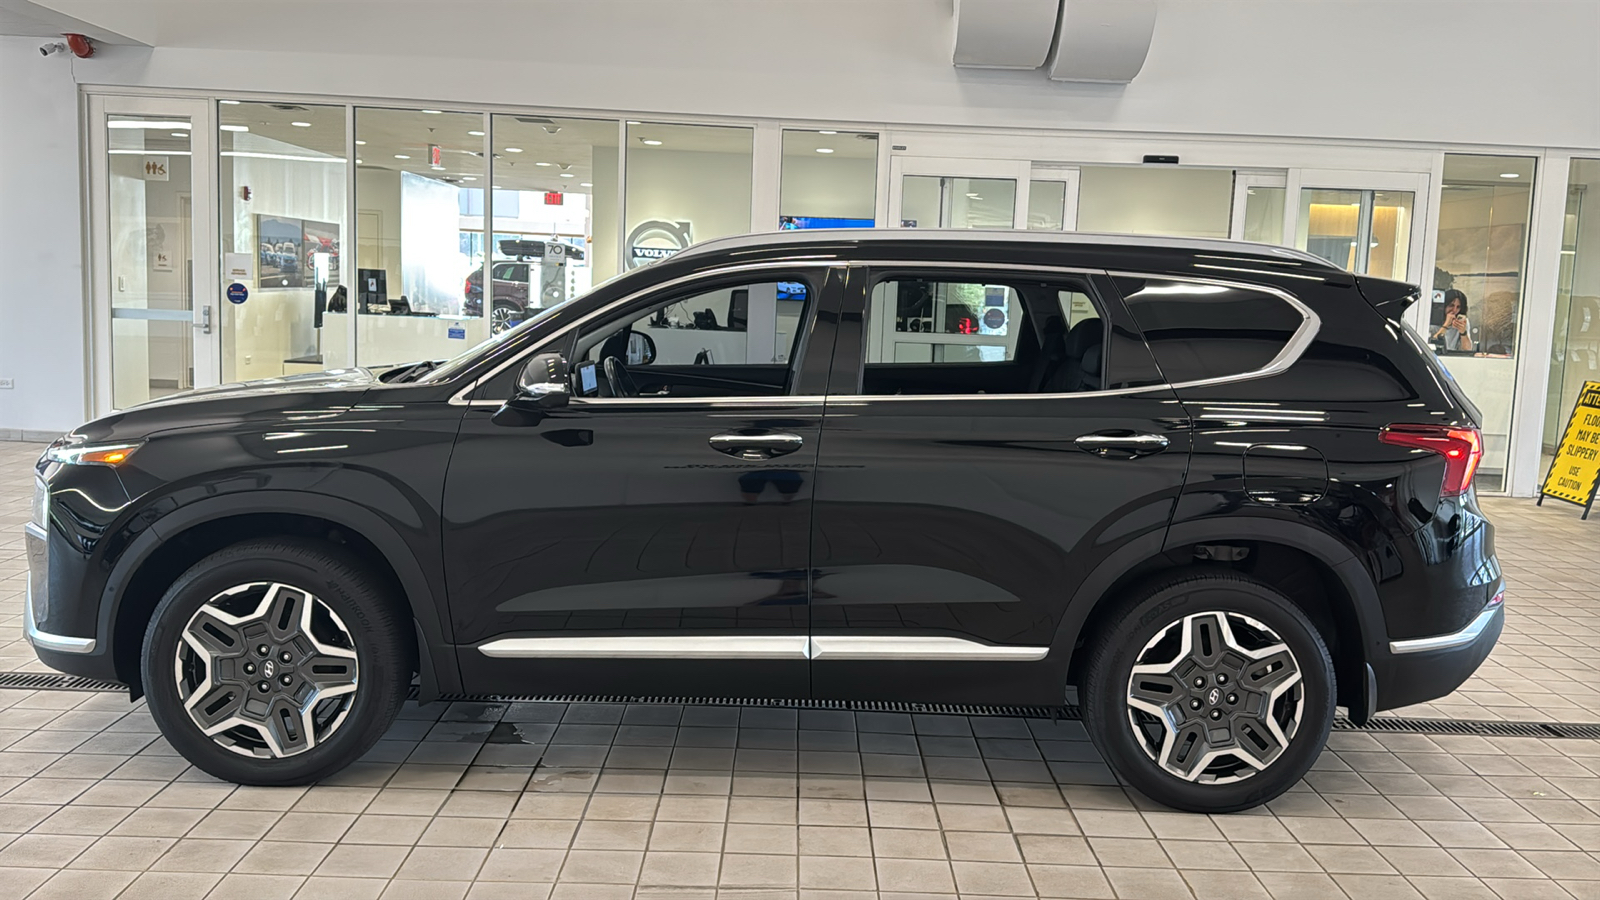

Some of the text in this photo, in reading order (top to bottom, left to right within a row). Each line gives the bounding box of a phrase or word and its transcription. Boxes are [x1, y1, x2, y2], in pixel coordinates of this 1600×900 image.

[548, 245, 563, 255] 70
[1583, 414, 1600, 428] FLOO
[1575, 429, 1600, 445] MAY BE
[1566, 444, 1599, 461] SLIPPERY
[1569, 465, 1581, 476] USE
[1557, 476, 1582, 491] CAUTION
